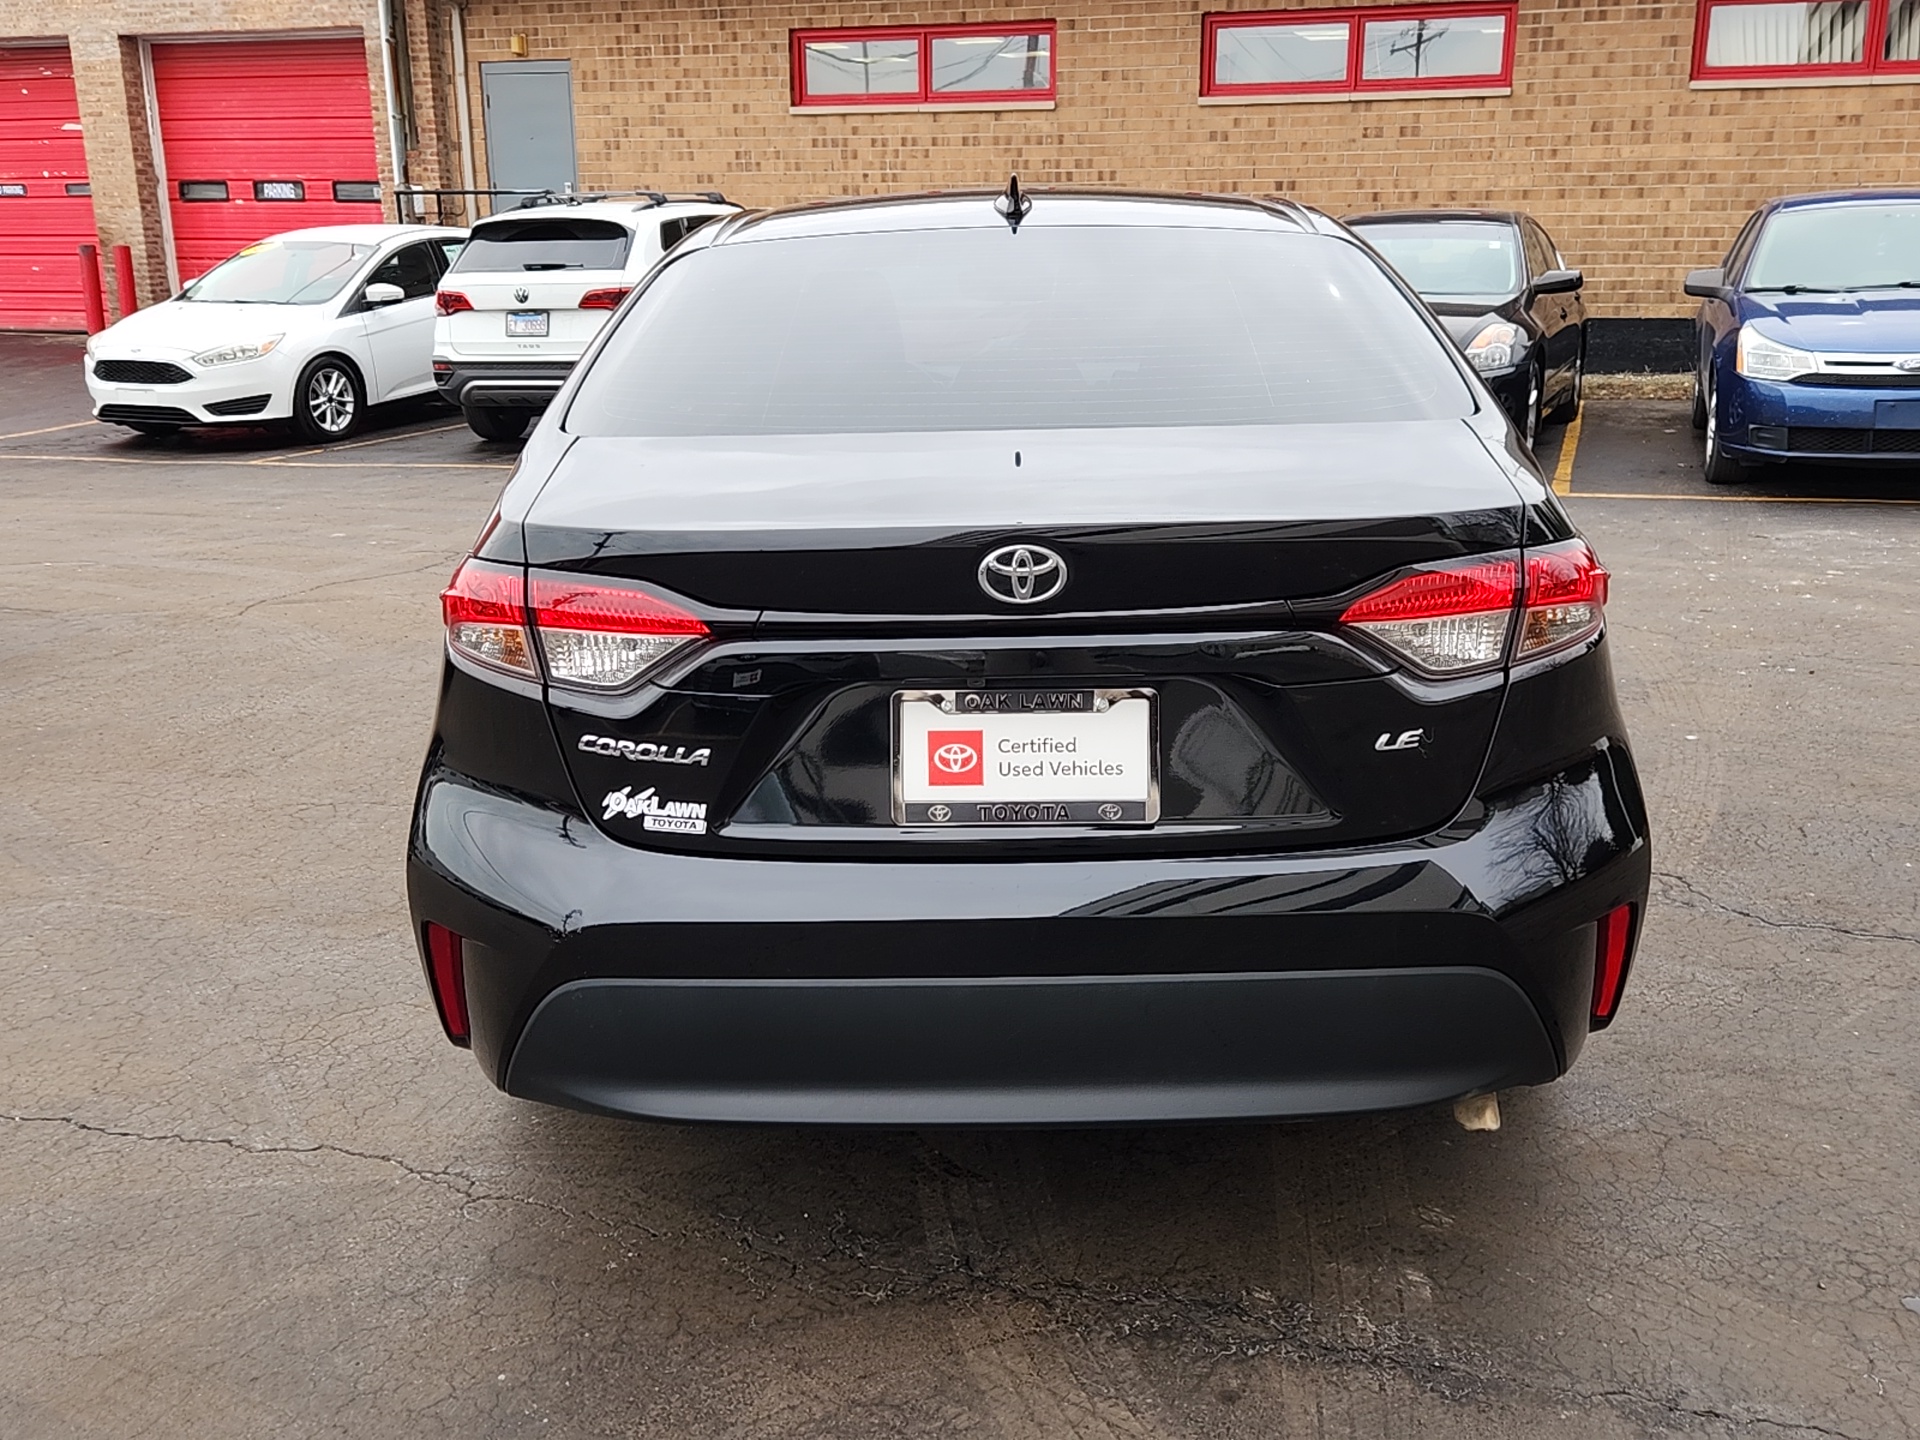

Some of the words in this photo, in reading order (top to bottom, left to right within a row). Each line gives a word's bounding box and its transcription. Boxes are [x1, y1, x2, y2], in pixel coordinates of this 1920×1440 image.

[964, 693, 1012, 710] OAK
[1019, 693, 1083, 709] LAWN
[997, 736, 1077, 754] Certified
[1374, 727, 1424, 751] LE
[577, 734, 711, 767] COROLLA
[998, 761, 1044, 777] Used
[1048, 760, 1125, 777] Vehicles
[977, 803, 1072, 822] TOYOTA
[650, 818, 698, 830] TOYOTA
